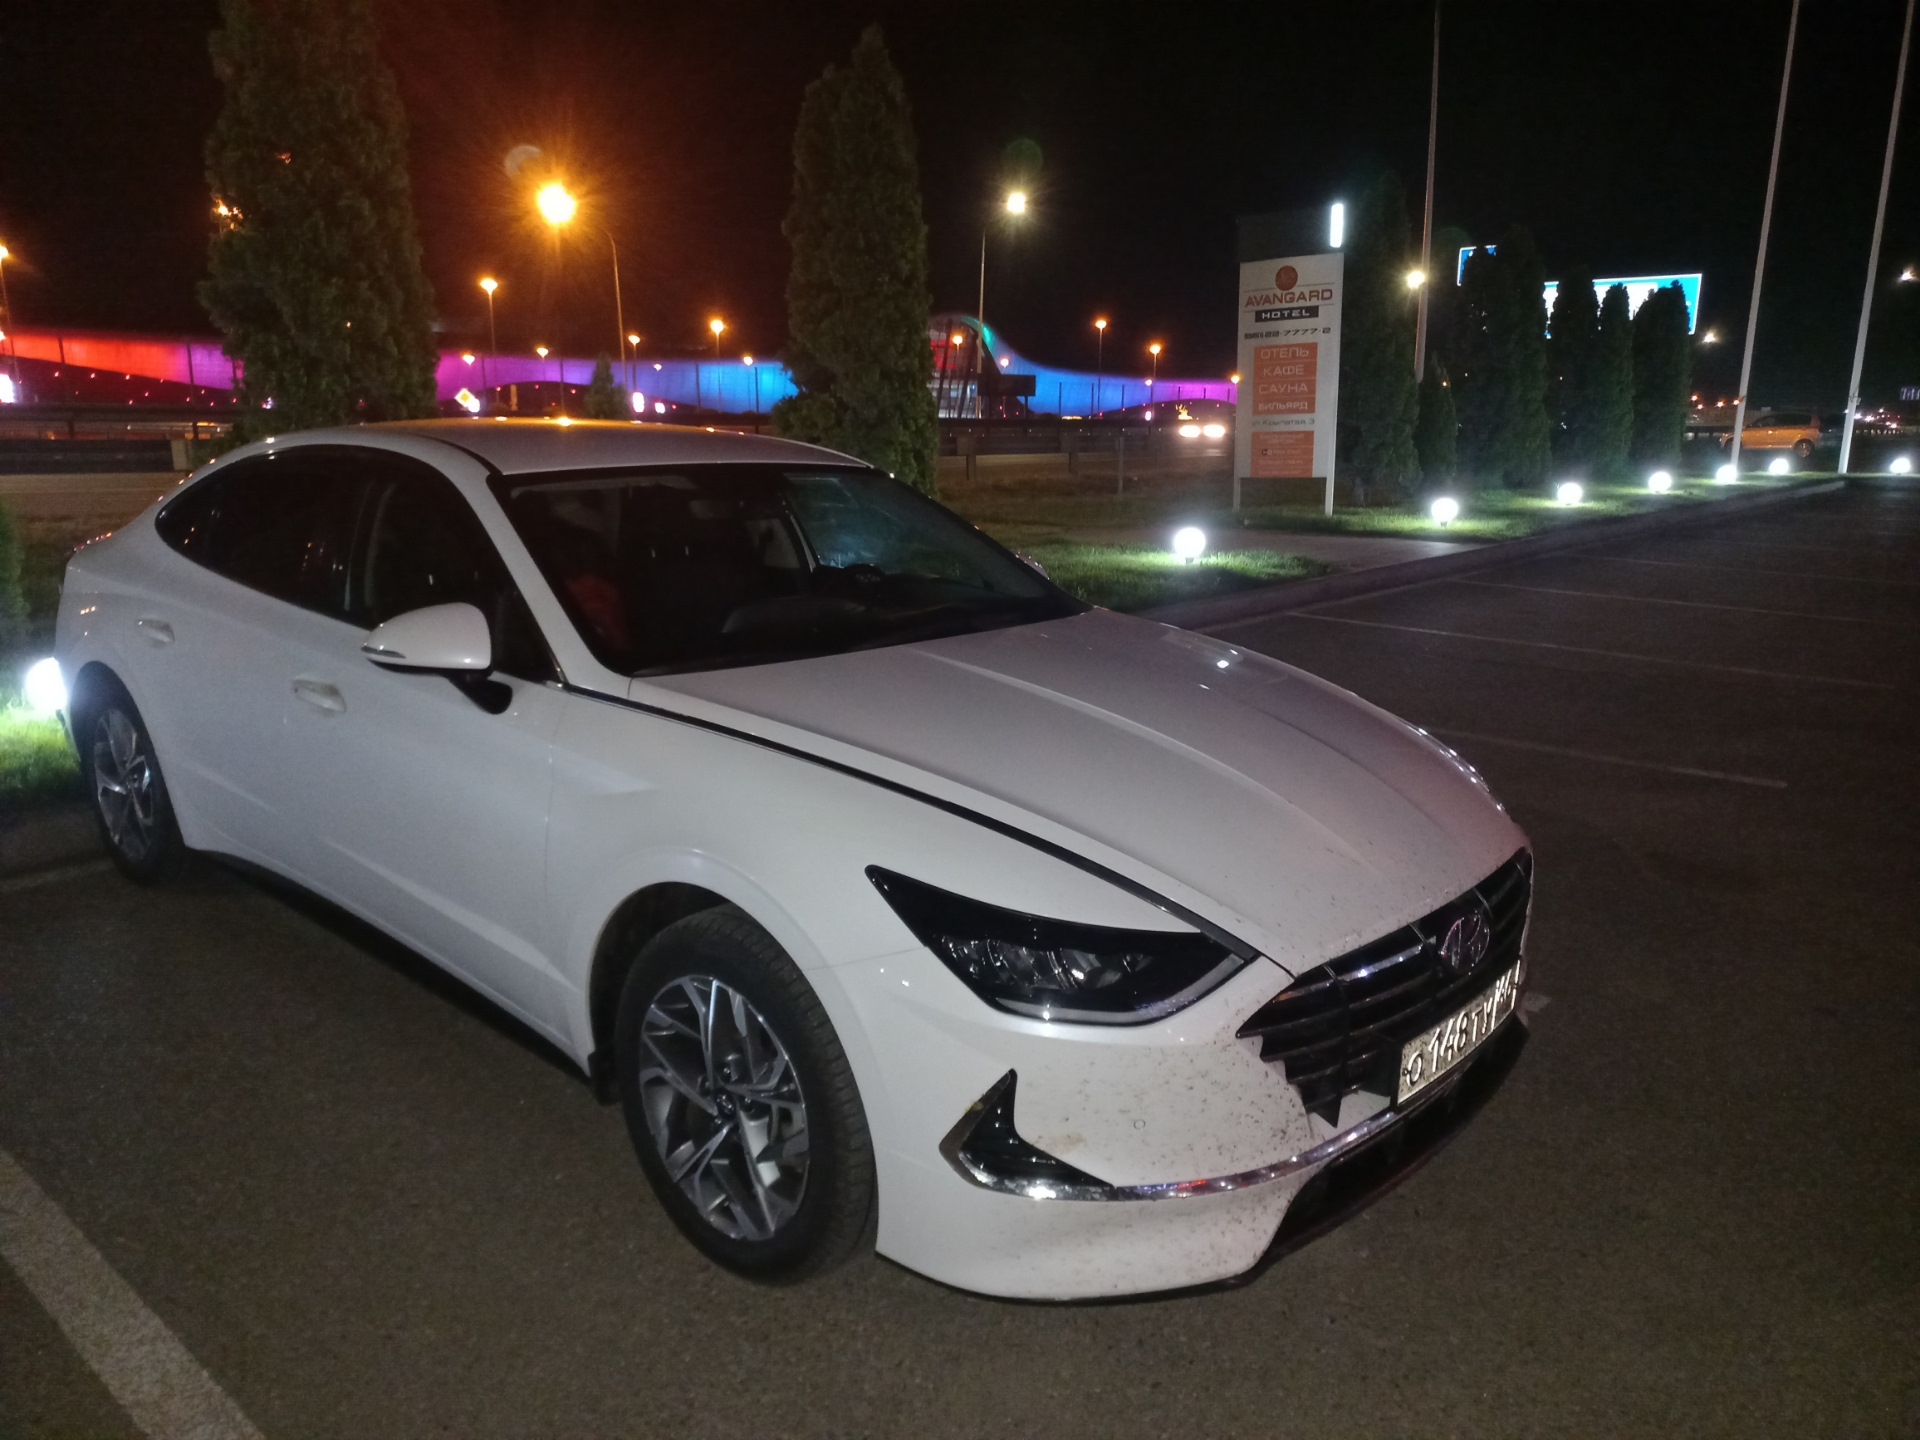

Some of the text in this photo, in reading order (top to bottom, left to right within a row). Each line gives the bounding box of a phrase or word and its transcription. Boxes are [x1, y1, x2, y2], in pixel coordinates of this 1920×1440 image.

[1245, 289, 1333, 307] AVANGARD
[1262, 309, 1310, 319] HOTEL
[1260, 347, 1309, 359] ОТЕЛЬ
[1263, 365, 1304, 376] КАФЕ
[1259, 382, 1308, 394] САУНА
[1258, 401, 1308, 411] БИЛЬЯРД
